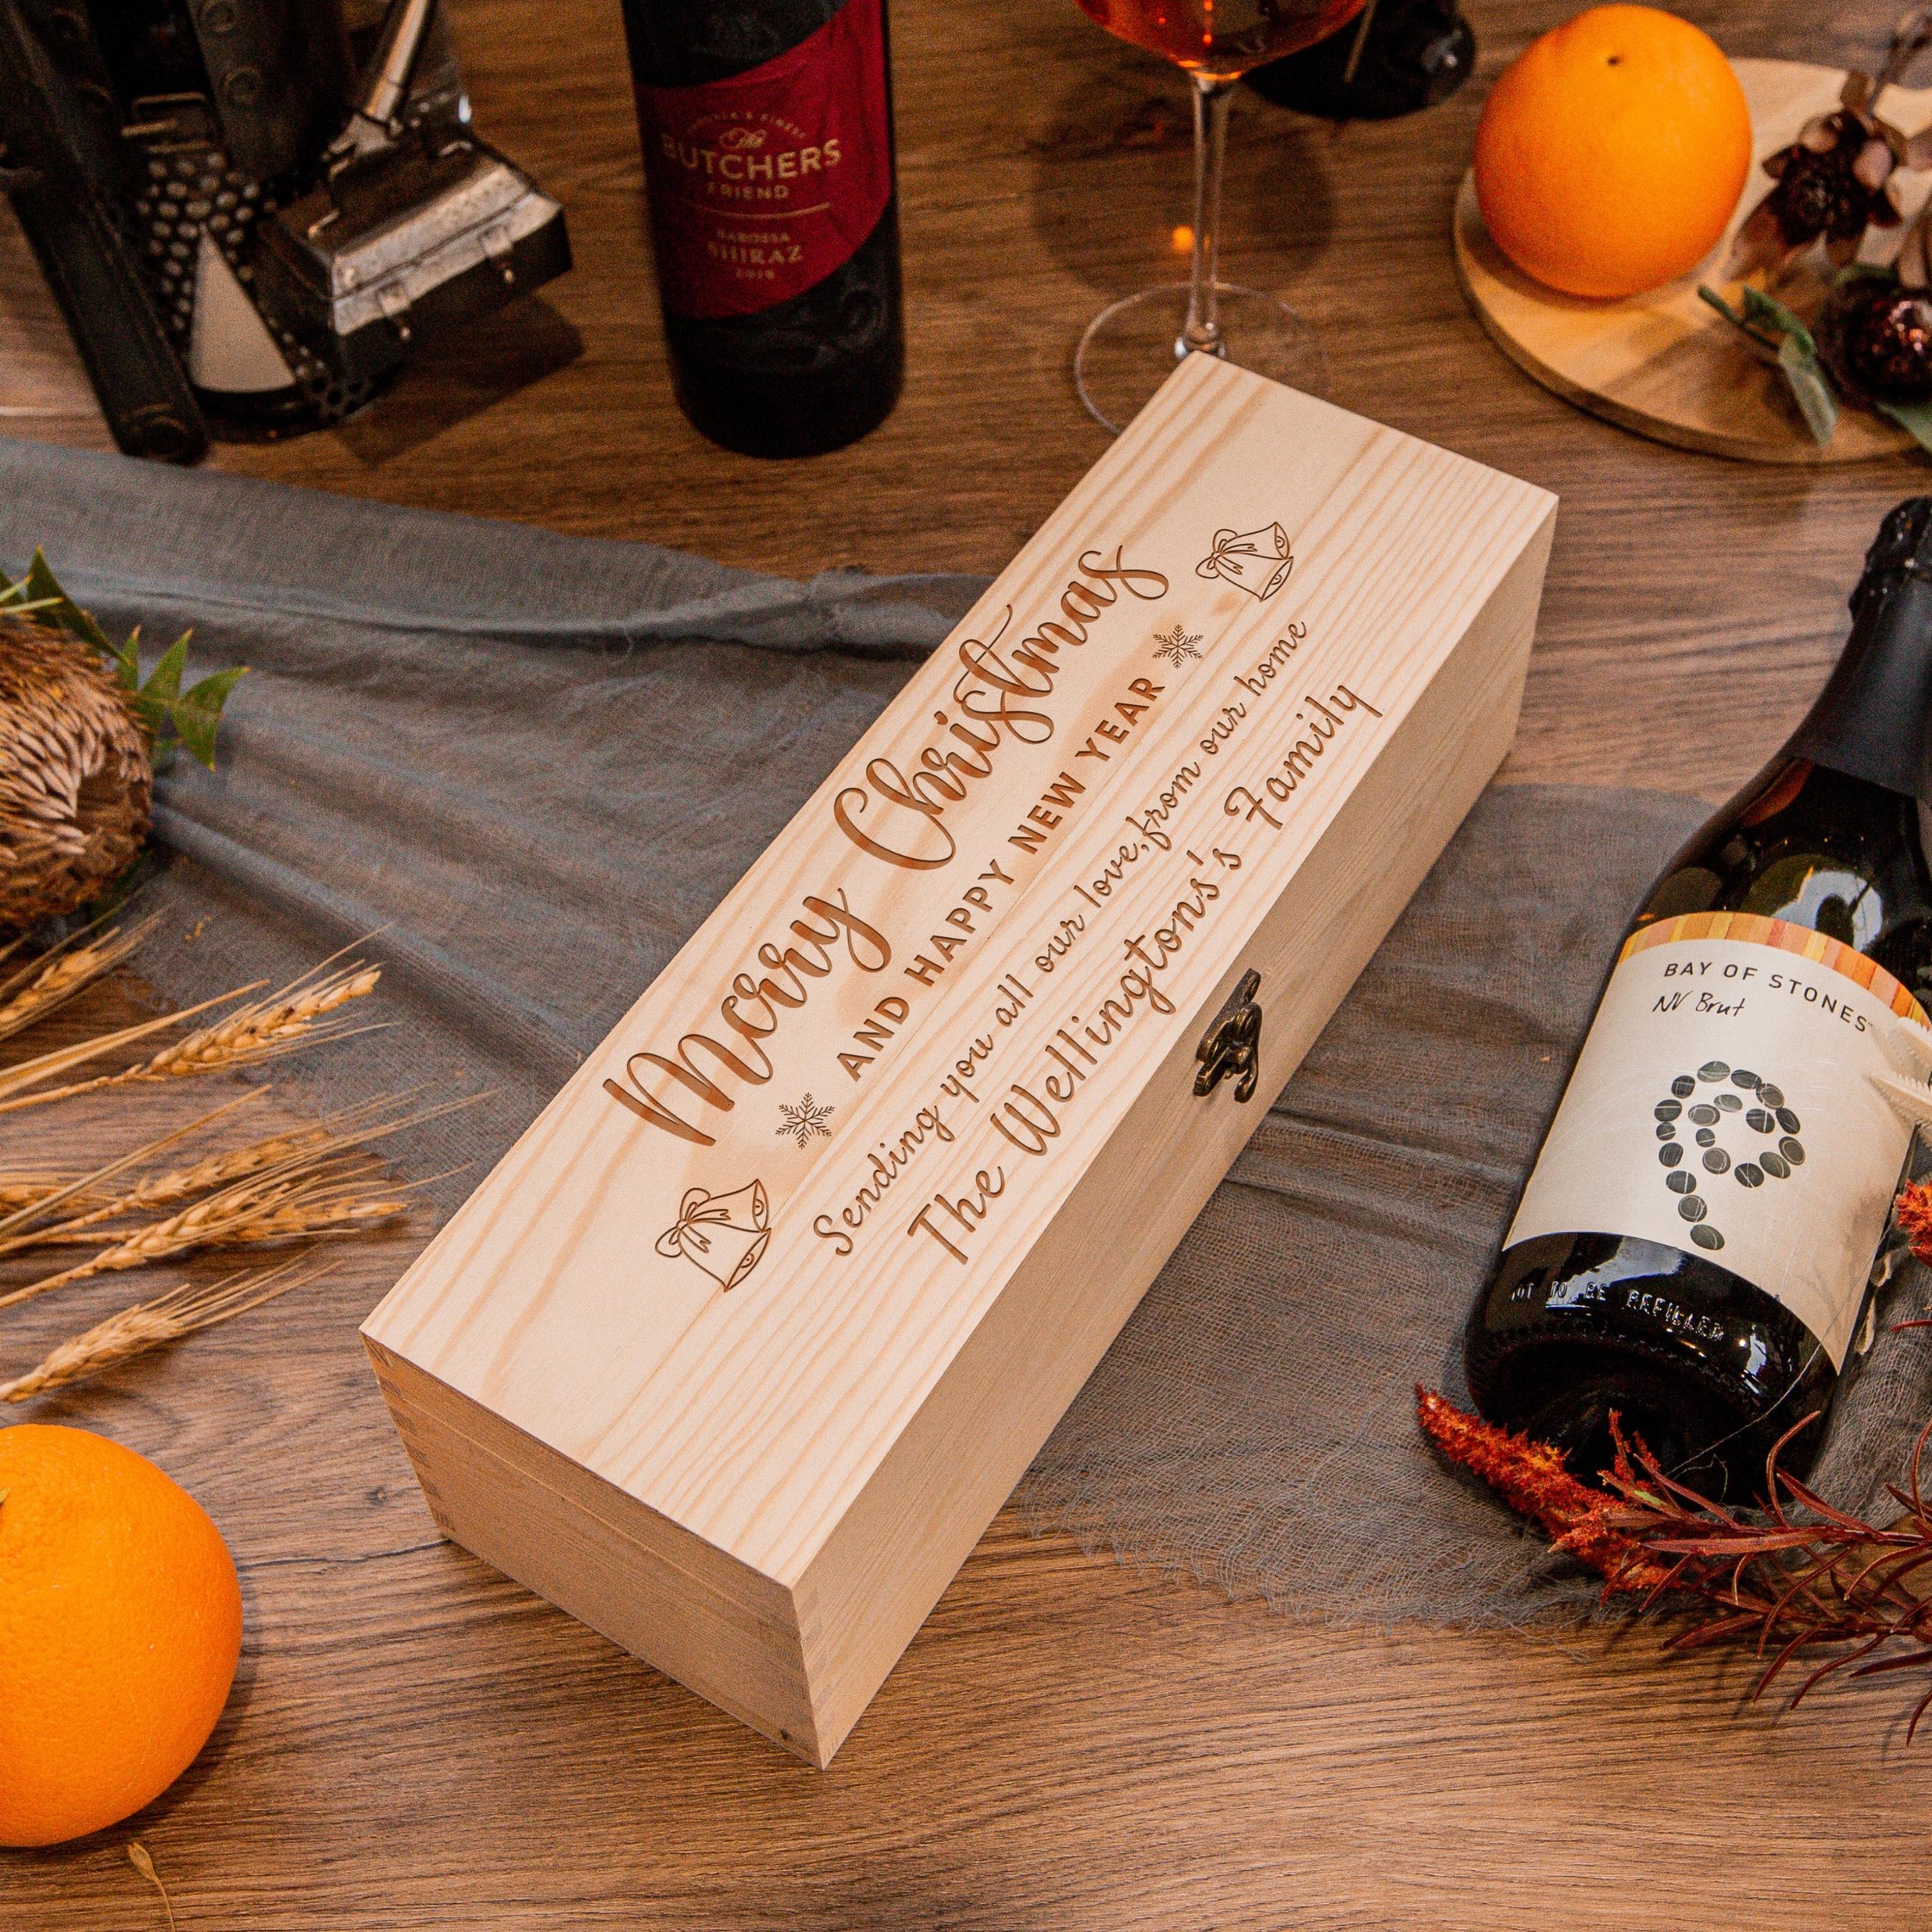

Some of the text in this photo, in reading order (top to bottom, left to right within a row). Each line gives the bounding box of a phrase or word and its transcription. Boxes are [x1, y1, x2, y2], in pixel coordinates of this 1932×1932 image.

[661, 132, 842, 180] BUTCHERS
[706, 182, 790, 200] FRIEND
[707, 240, 803, 264] SHIRAZ
[602, 545, 1169, 1146] Merry Christmas
[836, 677, 1166, 1083] AND HAPPY NEW YEAR
[813, 1104, 955, 1257] Sending
[940, 1033, 994, 1103] you
[995, 974, 1034, 1028] all
[1035, 914, 1085, 973] our
[1199, 702, 1246, 755] our
[1234, 621, 1307, 697] home
[907, 685, 1384, 1266] The Wellingtons's Family
[1664, 961, 1712, 977] BAY
[1723, 964, 1758, 980] OF
[1652, 990, 1746, 1017] NV Brut
[1550, 1281, 1568, 1299] TO
[1584, 1282, 1609, 1301] BE
[1626, 1289, 1724, 1341] REFILLED
